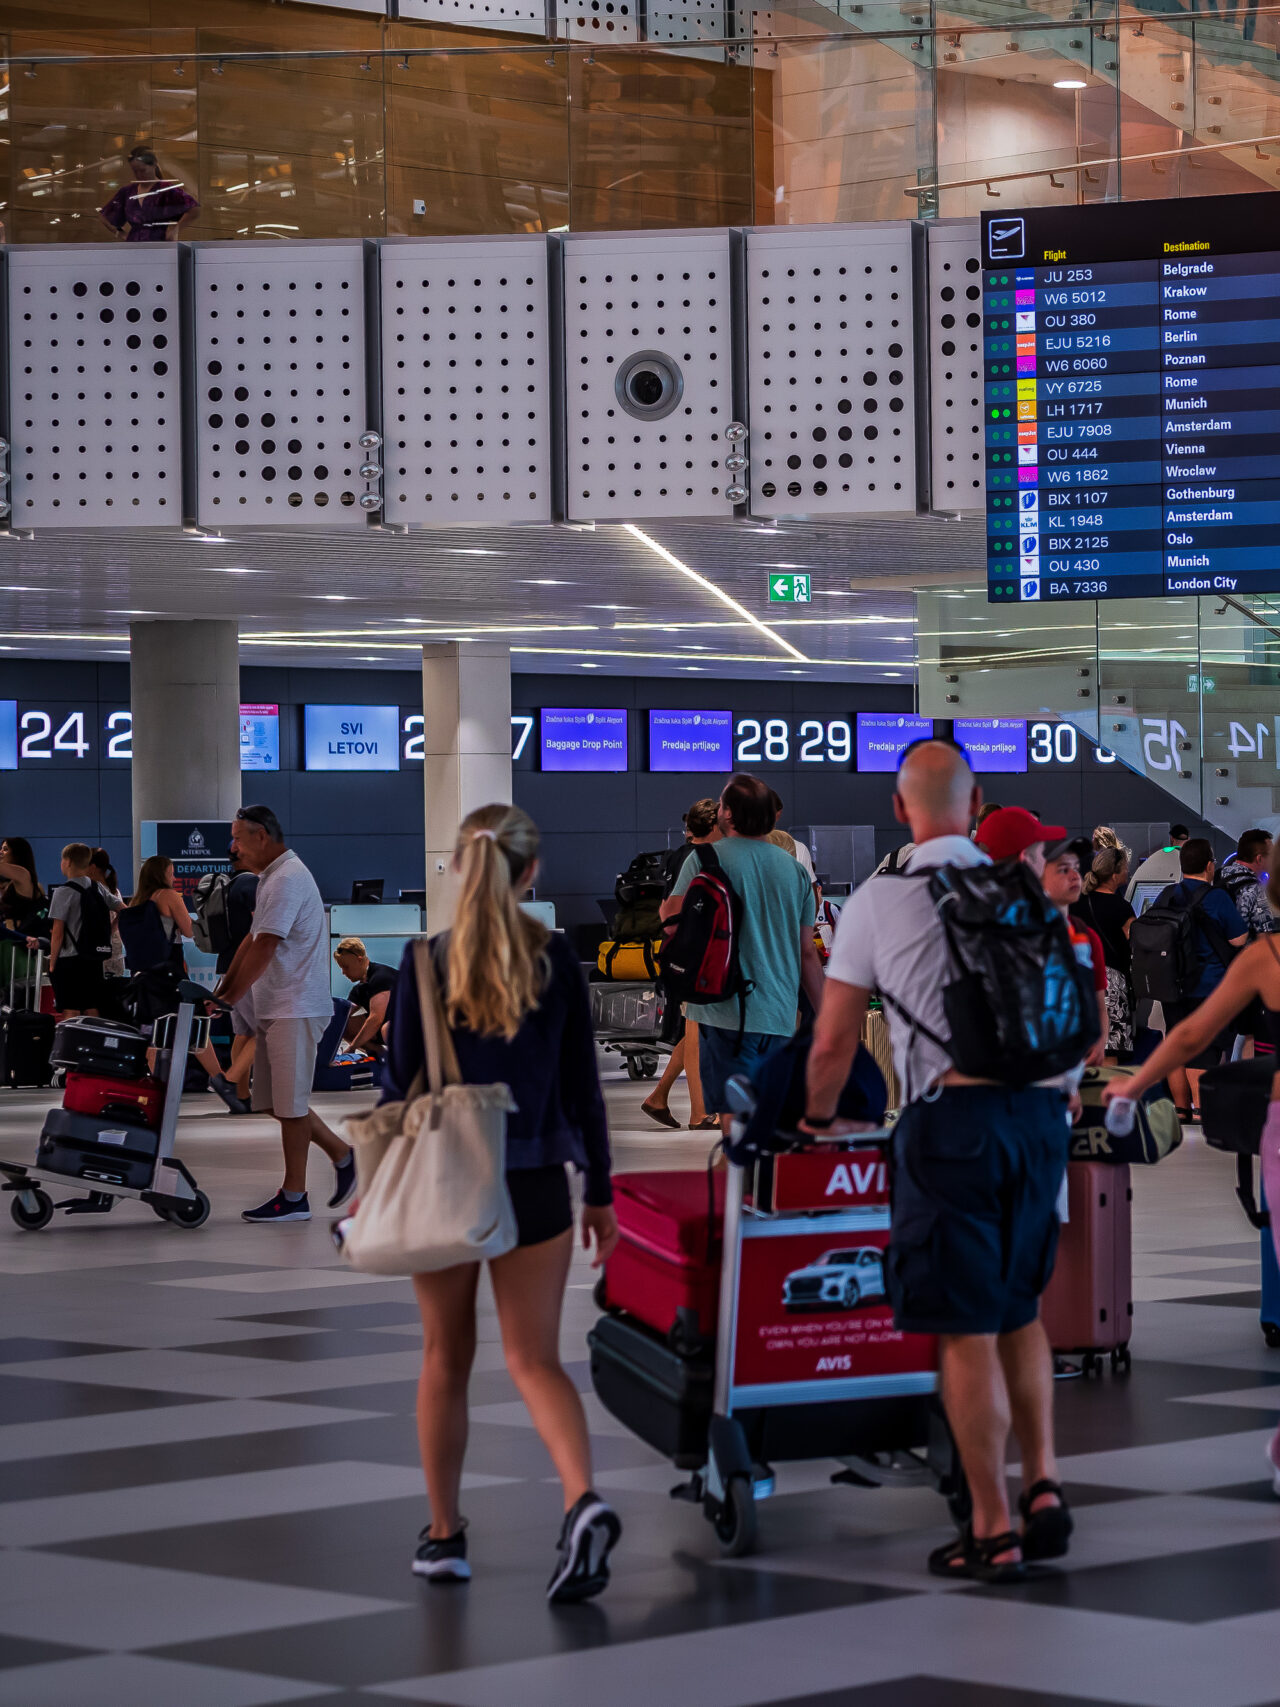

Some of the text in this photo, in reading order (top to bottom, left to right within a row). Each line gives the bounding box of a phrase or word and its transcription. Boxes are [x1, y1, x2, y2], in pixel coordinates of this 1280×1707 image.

[1043, 249, 1067, 262] Flight
[1163, 241, 1210, 253] Destination
[1044, 270, 1063, 283] JU
[1067, 268, 1093, 282] 253
[1163, 261, 1214, 277] Belgrade
[1045, 315, 1066, 328] OU
[1070, 313, 1096, 326] 380
[1164, 309, 1197, 321] Rome
[1045, 359, 1069, 372] W6
[1073, 357, 1108, 371] 6060
[1165, 354, 1206, 366] Poznan
[1047, 404, 1065, 417] LH
[1069, 402, 1103, 415] 1717
[1165, 396, 1208, 410] Munich
[1047, 426, 1073, 439] EJU
[1077, 424, 1112, 437] 7908
[1165, 418, 1232, 433] Amsterdam
[1047, 448, 1068, 461] OU
[1071, 447, 1098, 460] 444
[1165, 443, 1206, 455] Vienna
[1048, 493, 1071, 506] BIX
[1075, 492, 1108, 504] 1107
[1166, 486, 1235, 502] Gothenburg
[1048, 516, 1066, 528] KL
[1069, 514, 1103, 527] 1948
[1166, 509, 1233, 523] Amsterdam
[1049, 560, 1070, 572] OU
[1073, 558, 1100, 571] 430
[1167, 554, 1210, 568] Munich
[1050, 582, 1070, 595] BA
[1073, 581, 1108, 594] 7336
[1167, 577, 1211, 590] London
[1213, 576, 1238, 590] City
[21, 711, 132, 759] 24 2
[340, 722, 363, 735] SVI
[403, 715, 424, 760] 2
[510, 716, 534, 760] 7
[328, 741, 378, 755] LETOVI
[546, 739, 623, 751] Baggage Drop Point
[662, 740, 691, 752] Predaja
[737, 719, 789, 762] 28
[800, 720, 851, 762] 29
[868, 742, 895, 753] Predaja
[964, 742, 990, 753] Predaja
[1031, 720, 1077, 763] 30
[181, 848, 211, 856] INTERPOL
[825, 1162, 889, 1196] AVI
[815, 1355, 852, 1372] AVIS
